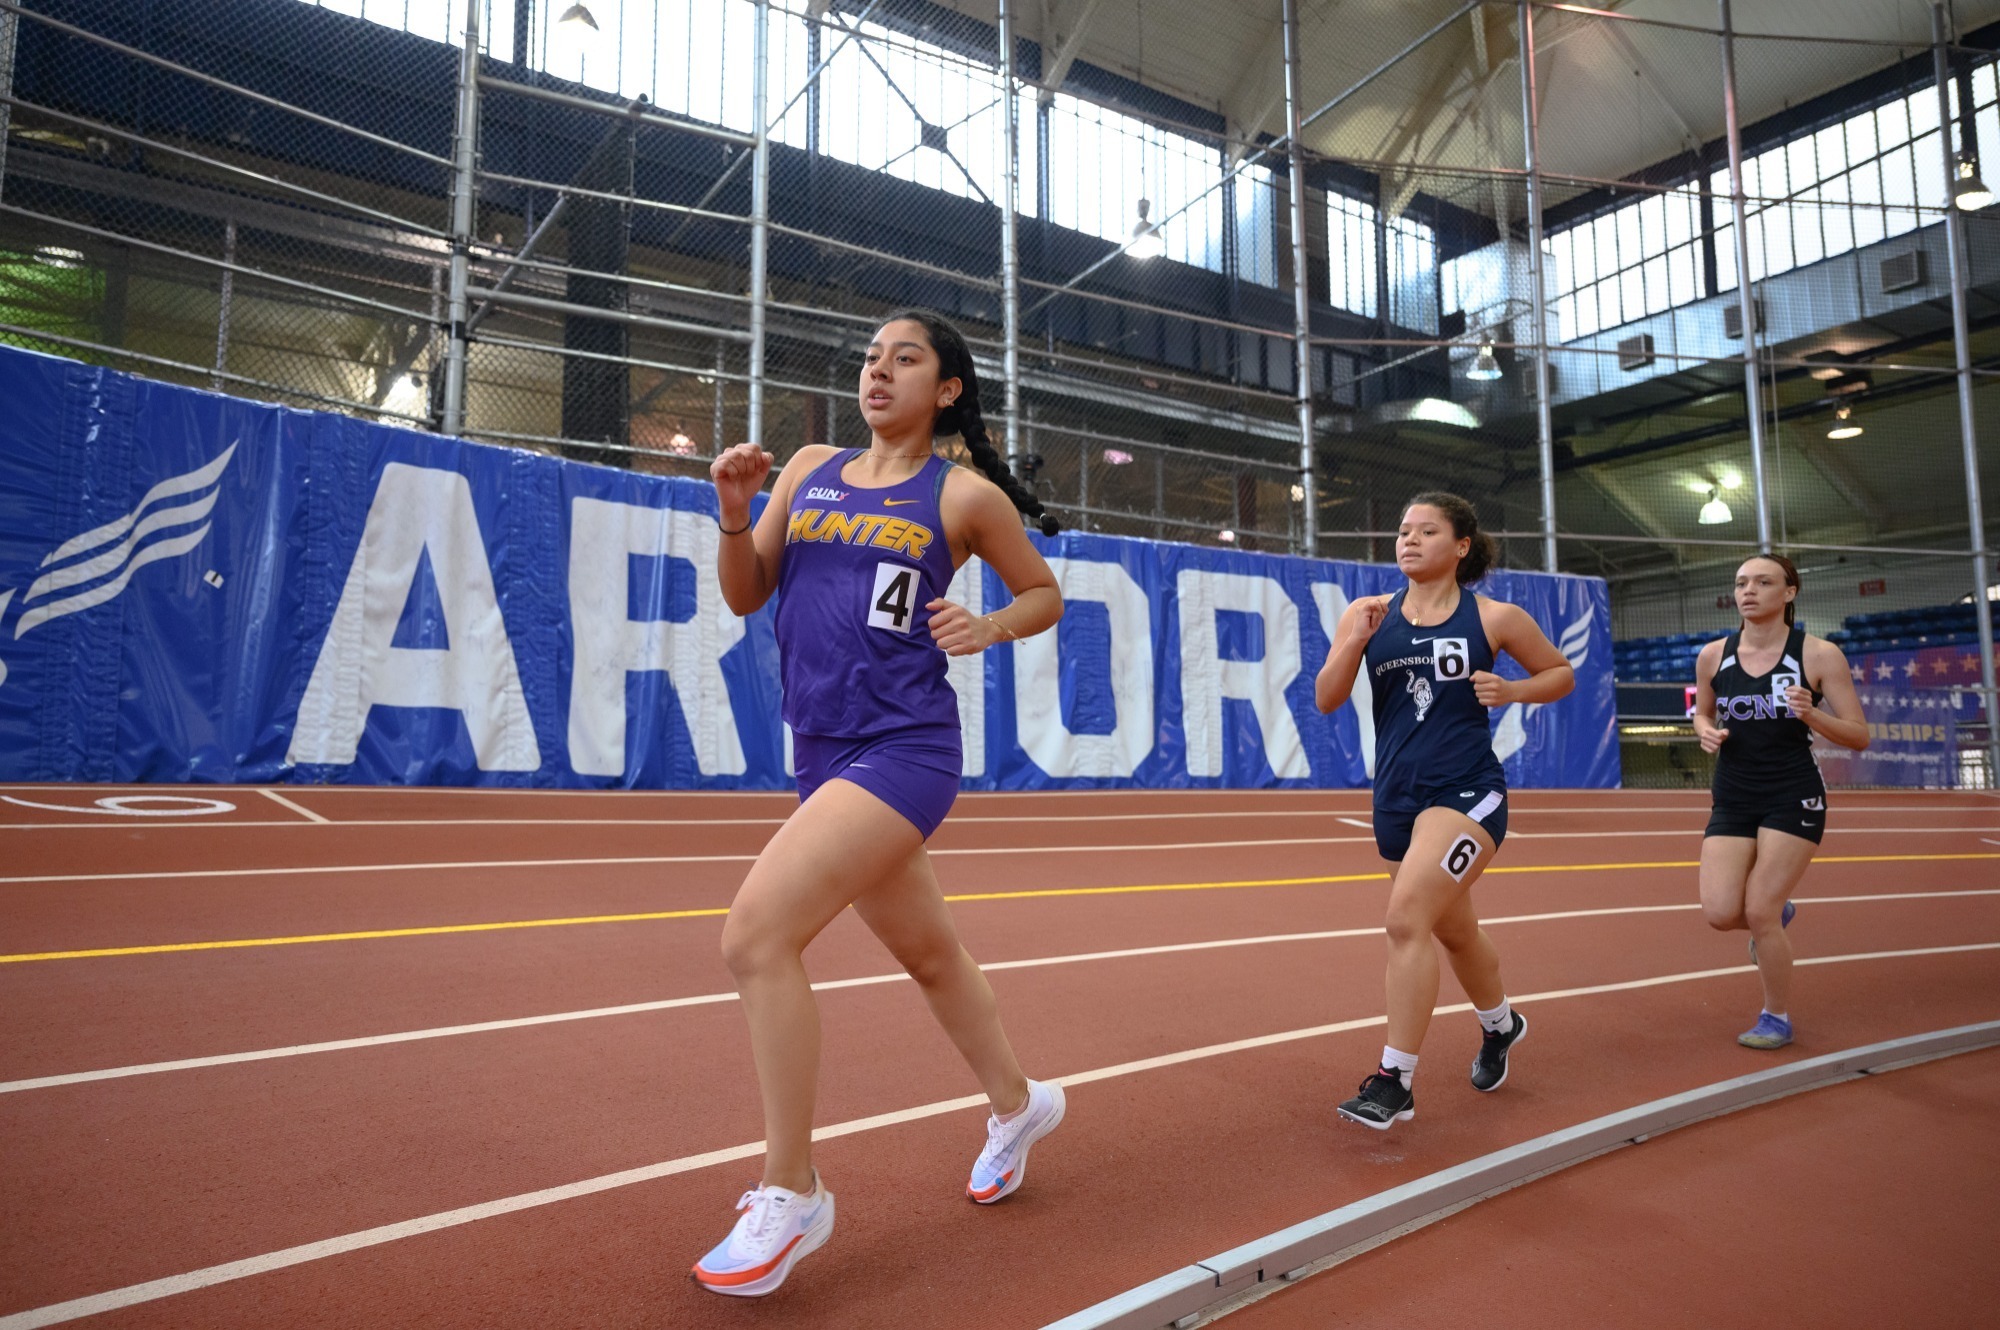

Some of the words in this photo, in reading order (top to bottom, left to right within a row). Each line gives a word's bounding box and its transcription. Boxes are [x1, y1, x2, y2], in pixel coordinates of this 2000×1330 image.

[805, 487, 850, 501] CUNY
[786, 509, 933, 560] HUNTER
[876, 571, 912, 627] 4
[1438, 641, 1465, 678] 6
[1447, 838, 1476, 876] 6
